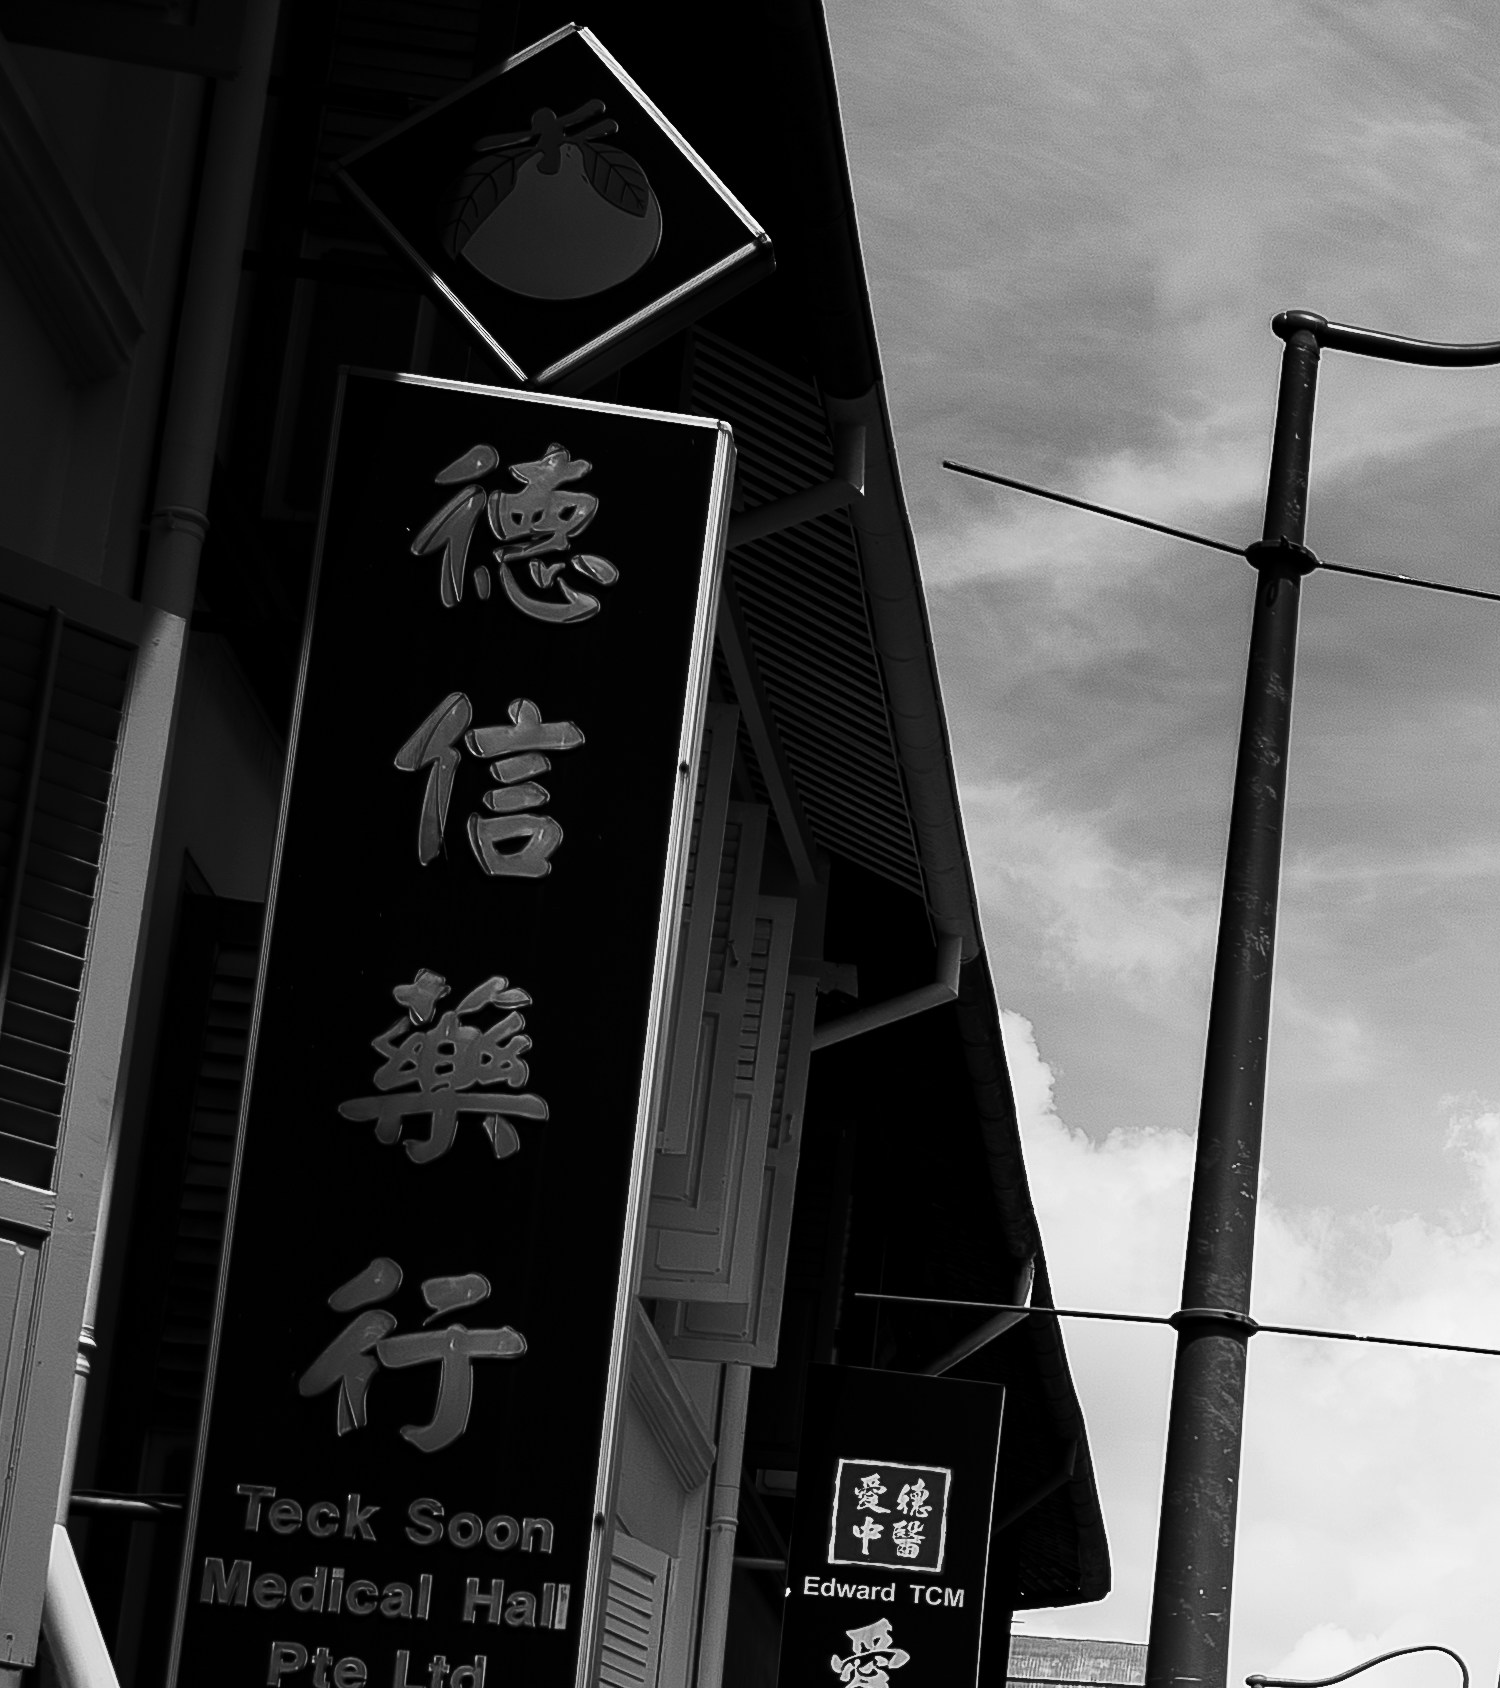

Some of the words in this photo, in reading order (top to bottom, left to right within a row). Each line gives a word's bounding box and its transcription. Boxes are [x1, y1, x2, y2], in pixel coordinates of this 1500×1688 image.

[235, 1483, 380, 1543] Teck
[405, 1497, 556, 1556] Soon
[199, 1556, 431, 1622] Medical
[462, 1576, 571, 1633] Hall
[803, 1576, 896, 1601] Edward
[909, 1585, 965, 1607] TCM
